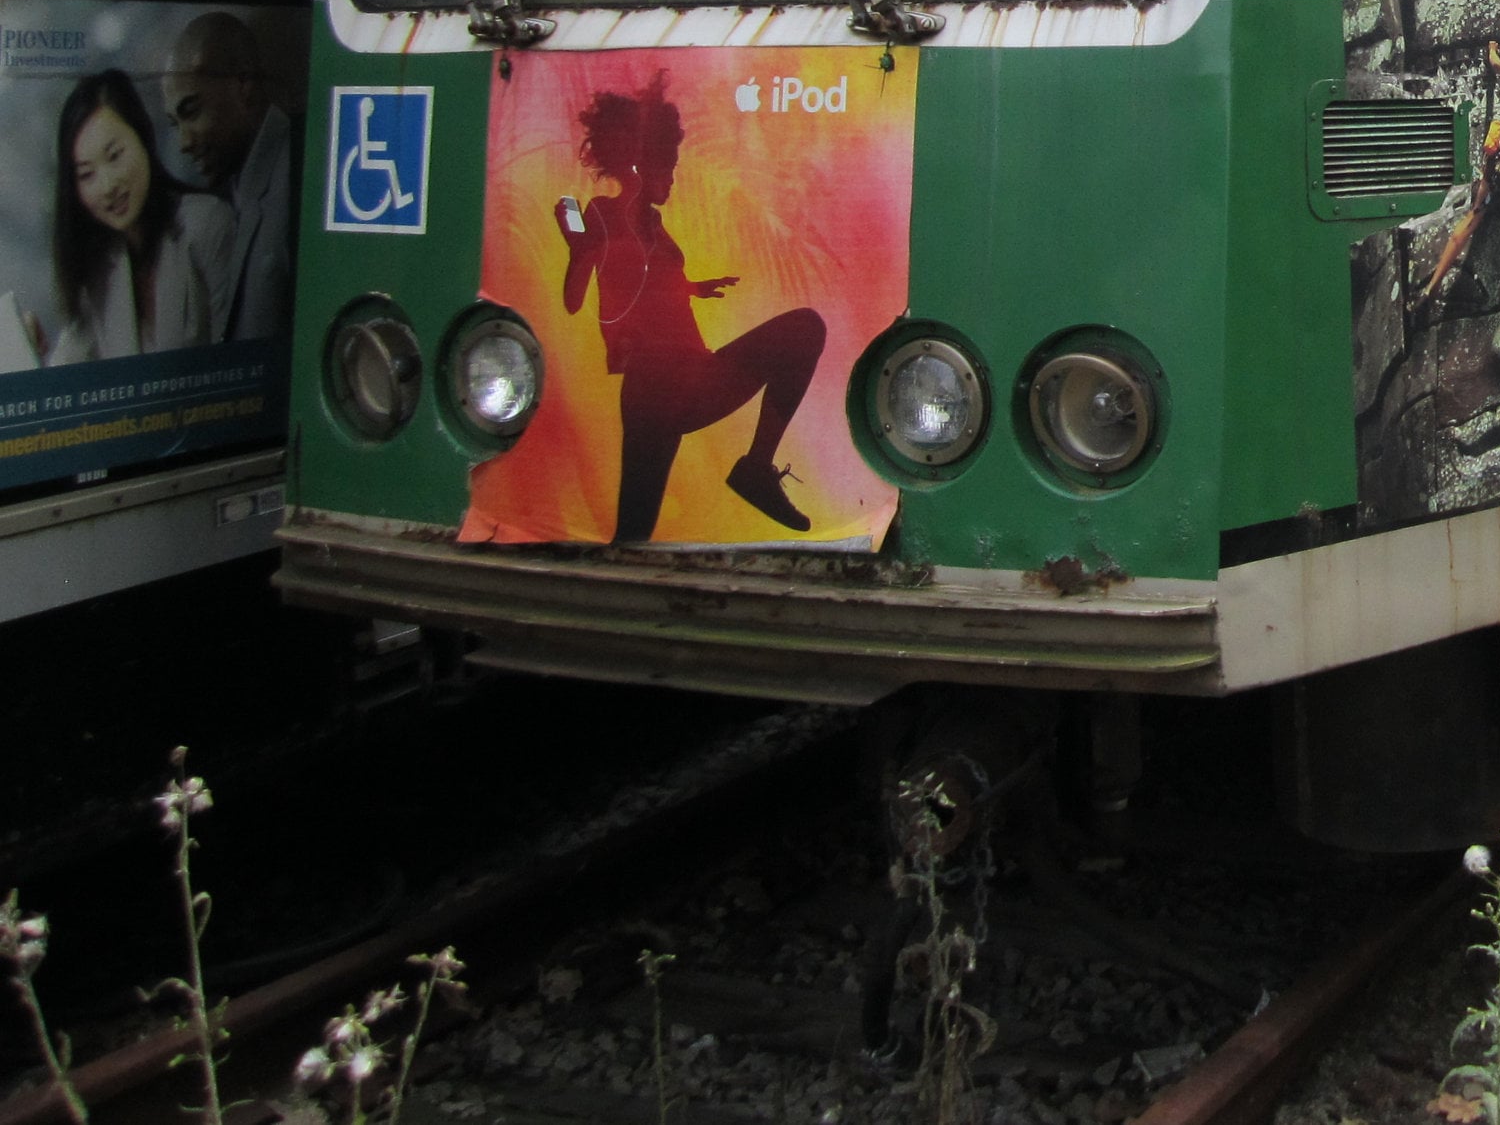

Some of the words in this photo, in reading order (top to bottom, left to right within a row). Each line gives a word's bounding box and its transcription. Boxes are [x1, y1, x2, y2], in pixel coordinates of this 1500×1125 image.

[4, 29, 86, 50] PIONEER
[5, 51, 87, 68] Investments
[772, 76, 847, 113] iPod
[45, 394, 72, 412] FOR
[80, 384, 136, 407] CAREER
[142, 367, 244, 396] OPPORTUNITIES
